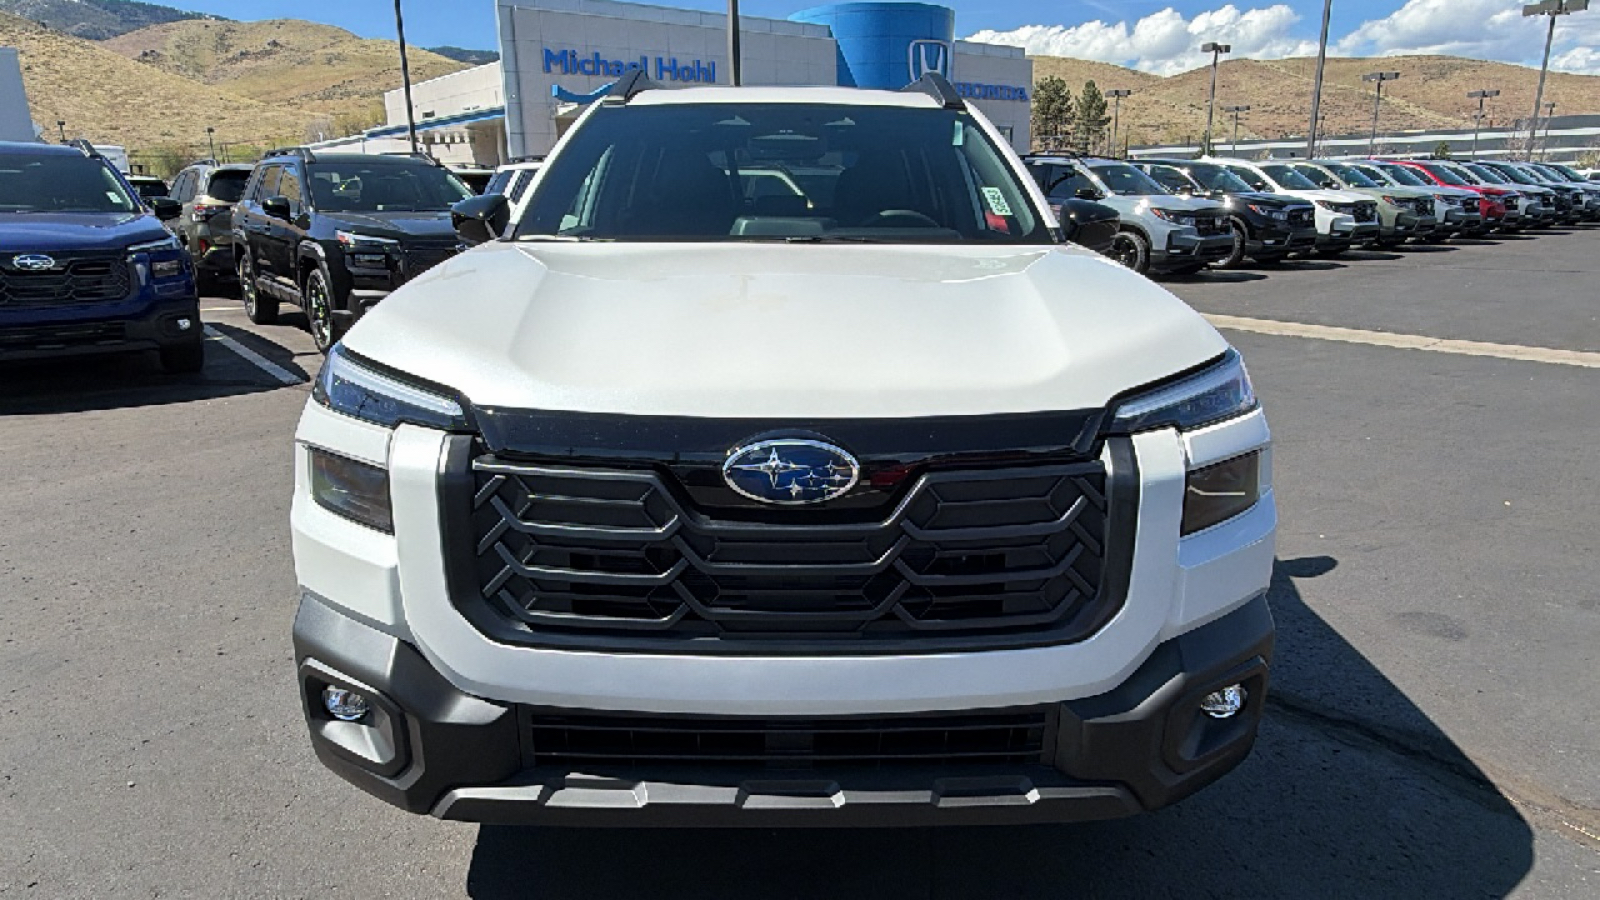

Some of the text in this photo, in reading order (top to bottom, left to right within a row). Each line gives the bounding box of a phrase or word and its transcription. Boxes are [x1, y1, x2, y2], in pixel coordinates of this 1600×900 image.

[543, 48, 716, 83] Michael Hohl
[955, 83, 1029, 100] HONDA
